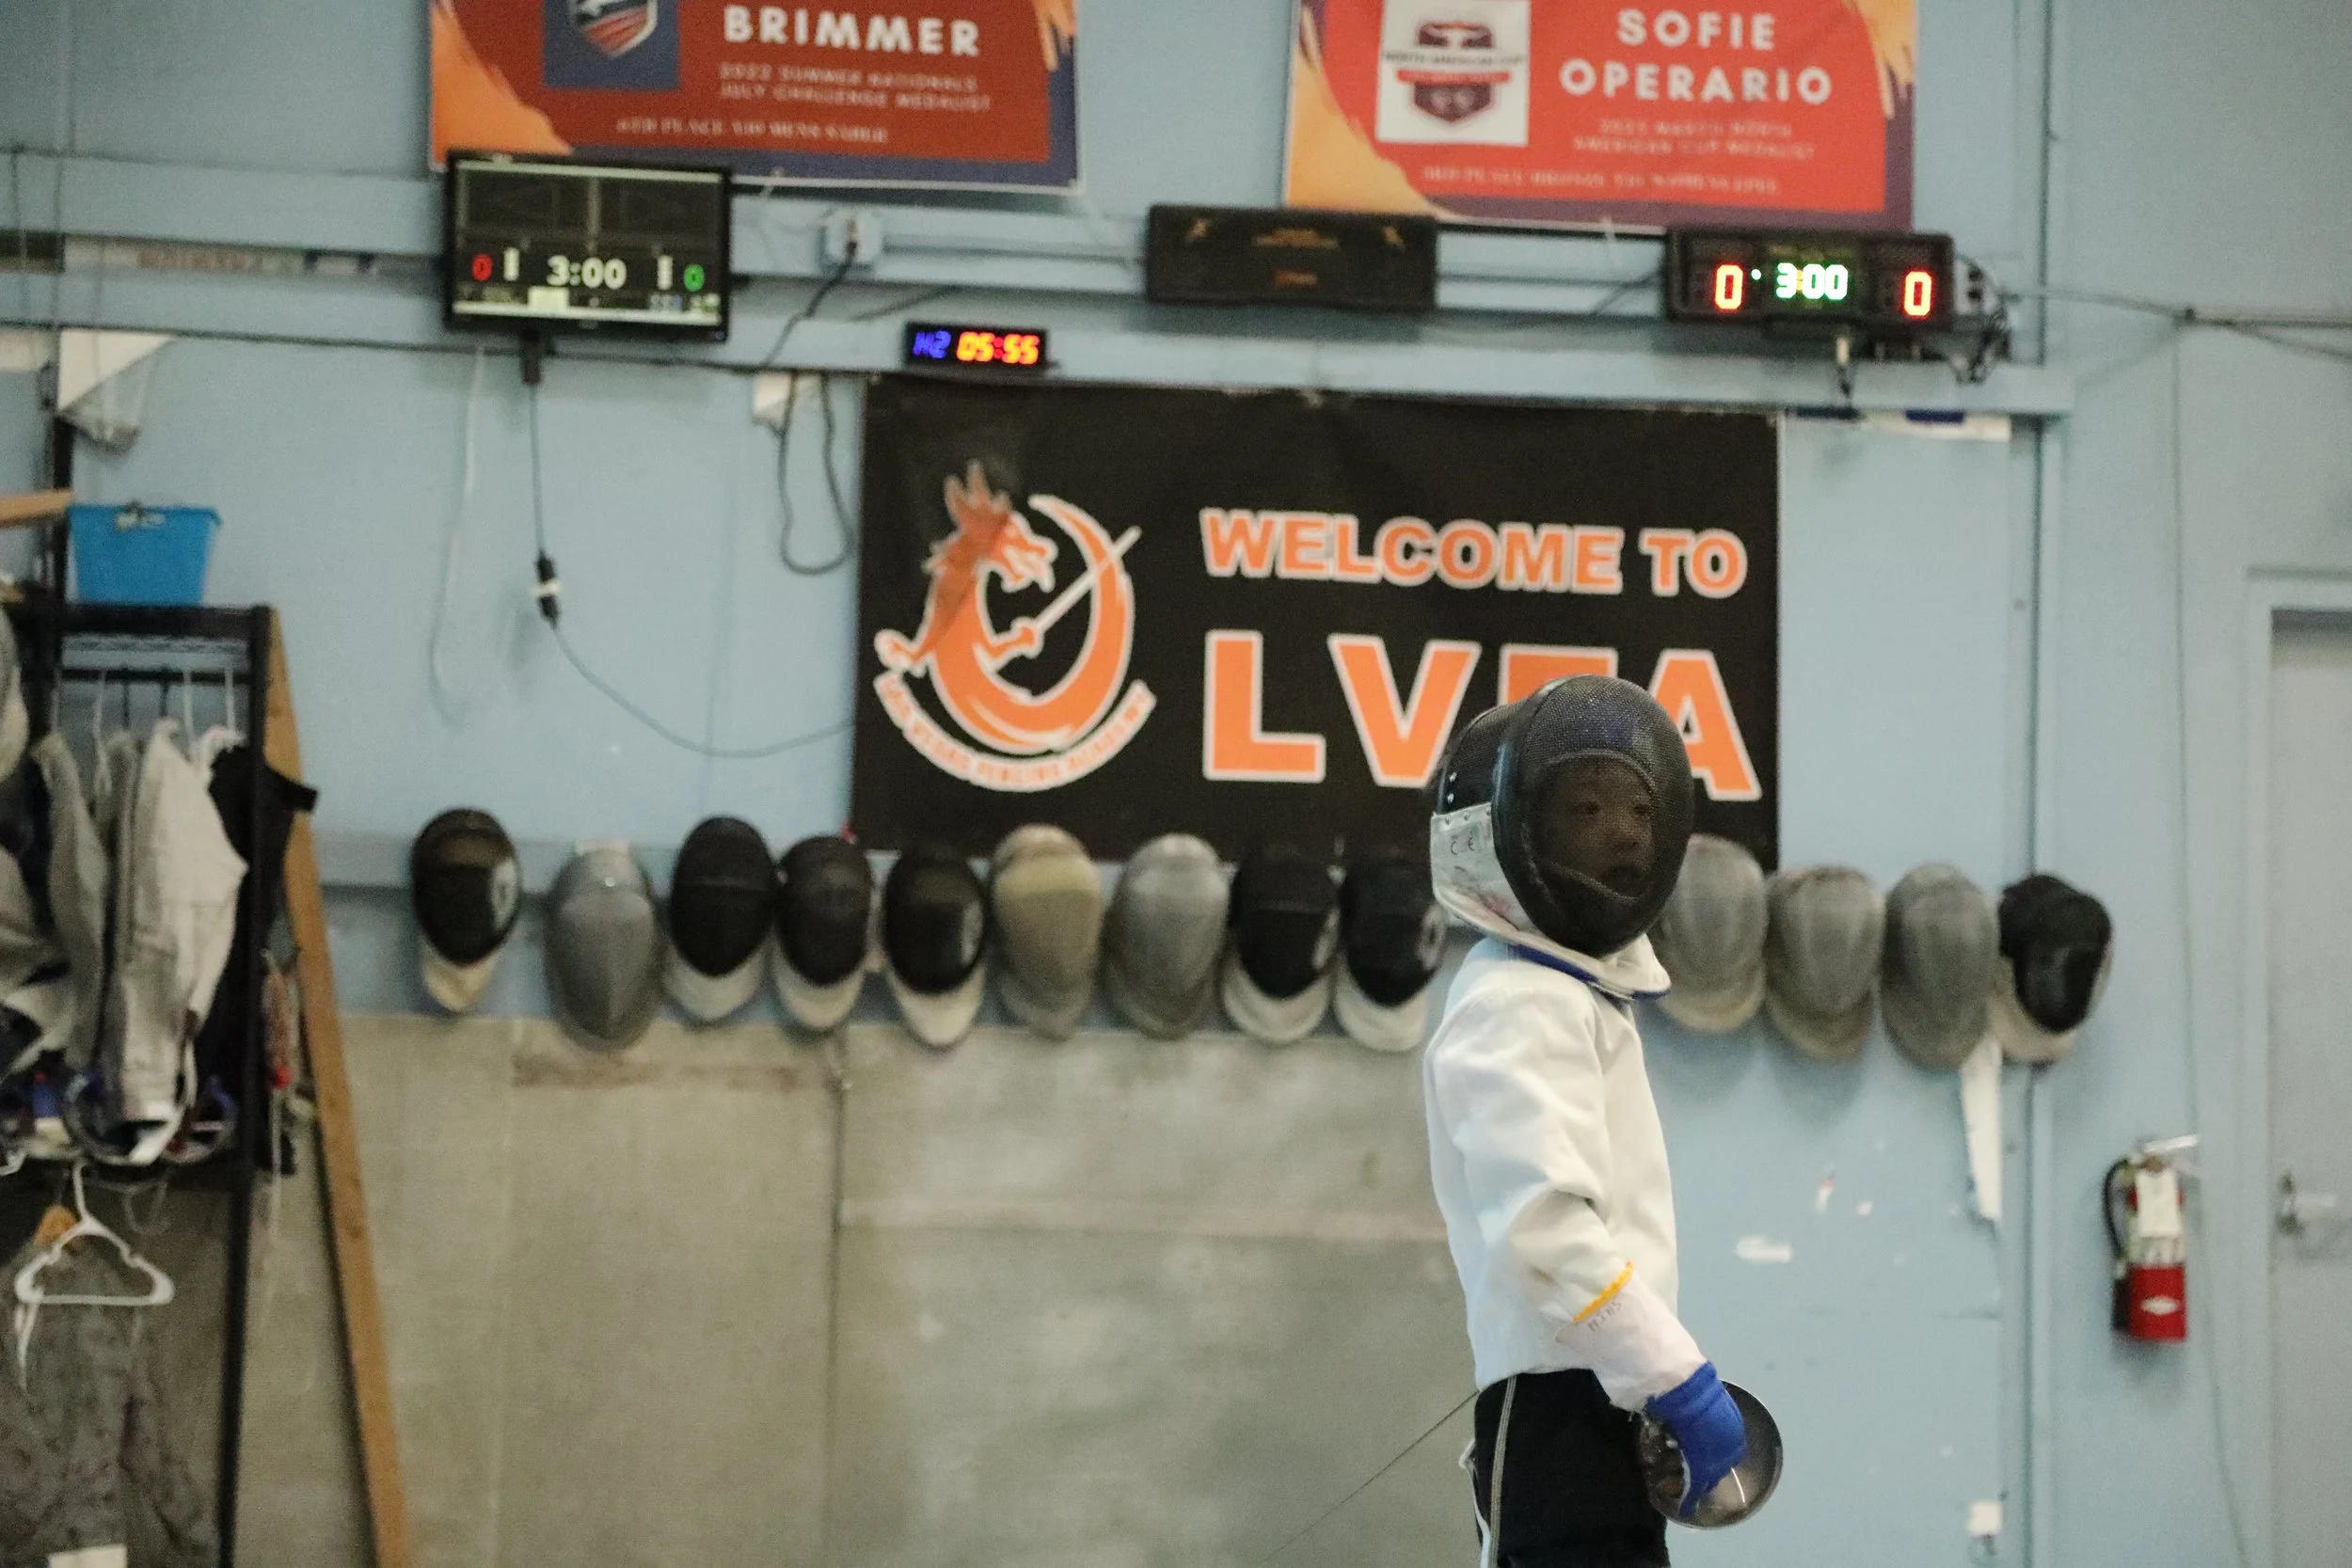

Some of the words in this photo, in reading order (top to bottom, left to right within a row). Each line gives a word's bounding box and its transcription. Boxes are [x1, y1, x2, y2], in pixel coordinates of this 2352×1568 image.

[723, 6, 979, 56] BRIMMER
[1615, 9, 1776, 52] SOFIE
[1559, 59, 1833, 105] OPERARIO
[472, 253, 492, 281] 0
[547, 255, 627, 289] 3:00
[684, 263, 705, 293] 0
[1714, 264, 1743, 309] 0
[1776, 262, 1849, 300] 3:00
[1904, 271, 1932, 316] 0
[956, 331, 1040, 365] 05:55
[1200, 508, 1625, 595] WELCOME
[1639, 528, 1748, 598] TO
